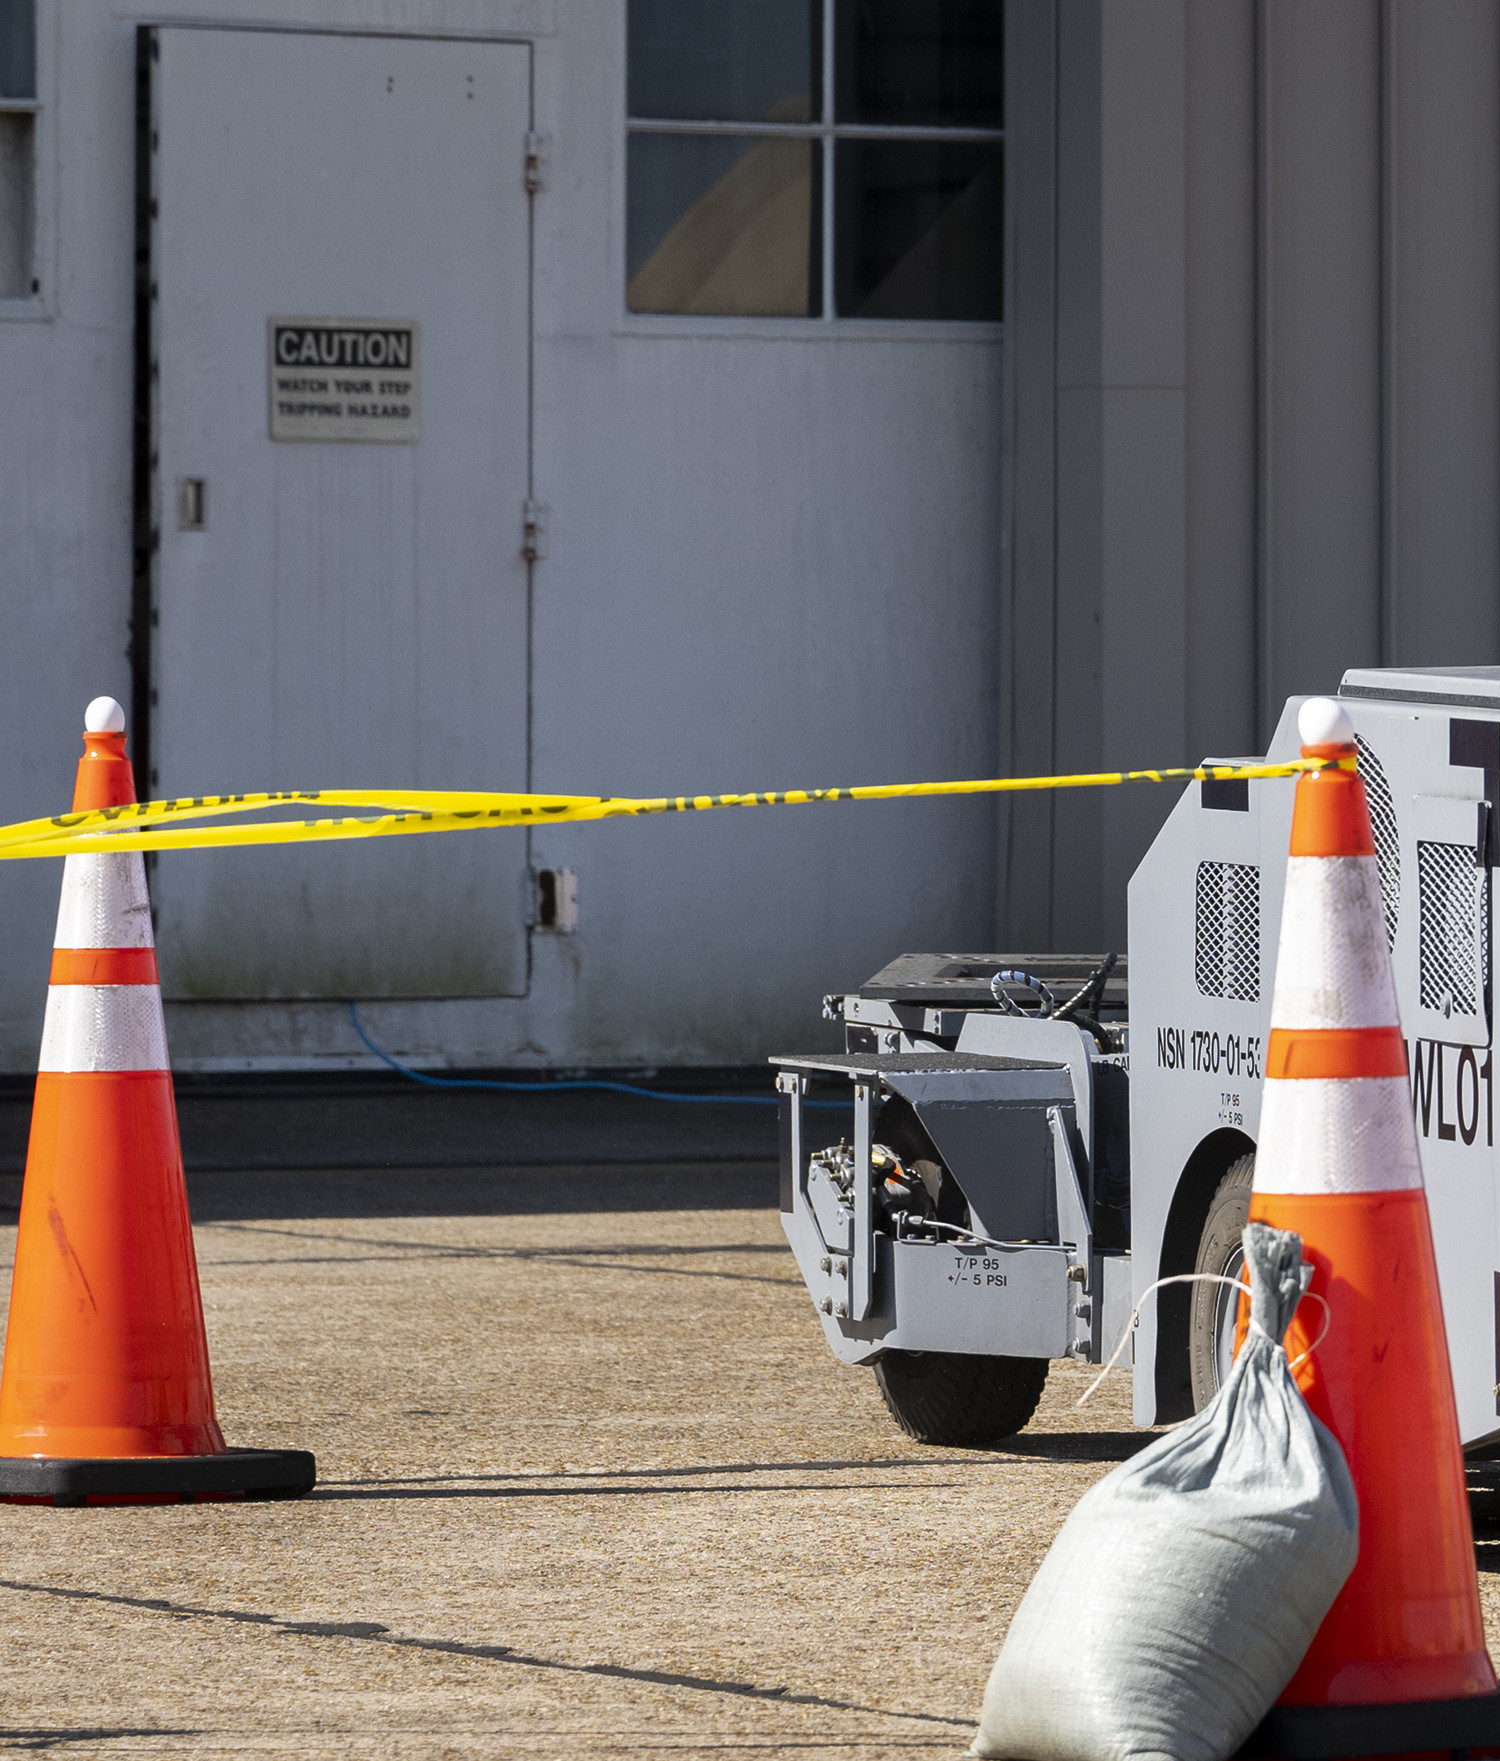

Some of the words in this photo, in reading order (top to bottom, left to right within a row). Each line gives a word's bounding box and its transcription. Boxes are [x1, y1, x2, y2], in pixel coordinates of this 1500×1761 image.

[278, 329, 409, 366] CAUTION
[277, 378, 329, 394] WATCH
[334, 379, 374, 395] YOUR
[379, 380, 412, 396] STEP
[278, 402, 342, 417] TRIPPING
[347, 403, 412, 419] HAZARD
[1157, 1027, 1185, 1070] NSN
[1220, 1092, 1231, 1106] T/P
[1232, 1094, 1240, 1107] 95
[1228, 1111, 1233, 1124] 5
[1234, 1112, 1244, 1126] PSI
[954, 1256, 978, 1270] T/P
[982, 1258, 1000, 1270] 95
[947, 1271, 968, 1286] +/-
[973, 1274, 982, 1286] 5
[986, 1274, 1007, 1287] PSI
